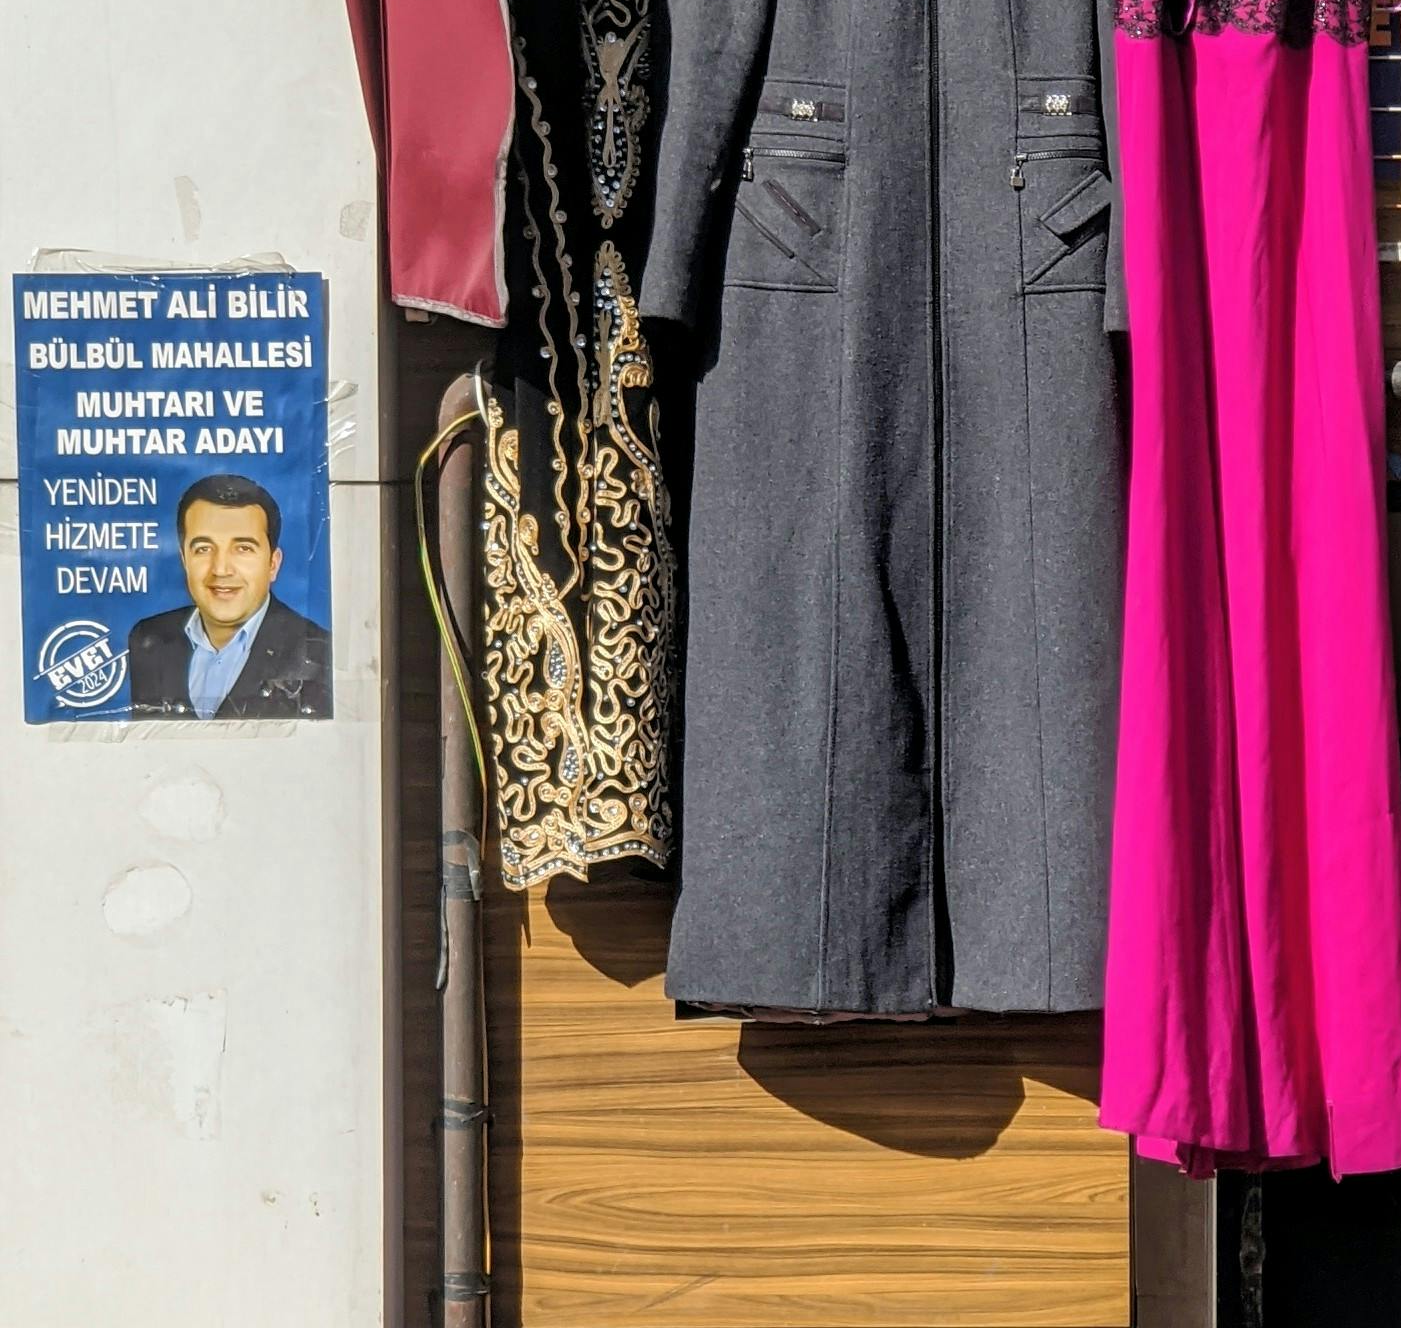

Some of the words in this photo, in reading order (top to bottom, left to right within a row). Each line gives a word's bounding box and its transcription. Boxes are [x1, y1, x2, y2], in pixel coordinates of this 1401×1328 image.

[23, 290, 158, 320] MEHMET
[167, 283, 216, 319] ALİ
[228, 283, 309, 319] BİLİR
[29, 337, 143, 370] BÜLBÜL
[152, 335, 312, 369] MAHALLESİ
[77, 391, 214, 418] MUHTARI
[223, 390, 264, 417] VE
[57, 428, 187, 455] MUHTAR
[195, 427, 284, 454] ADAYI
[44, 472, 158, 506] YENİDEN
[45, 516, 159, 551] HİZMETE
[57, 566, 148, 594] DEVAM
[46, 638, 115, 691] EVET
[77, 670, 109, 694] 2024
